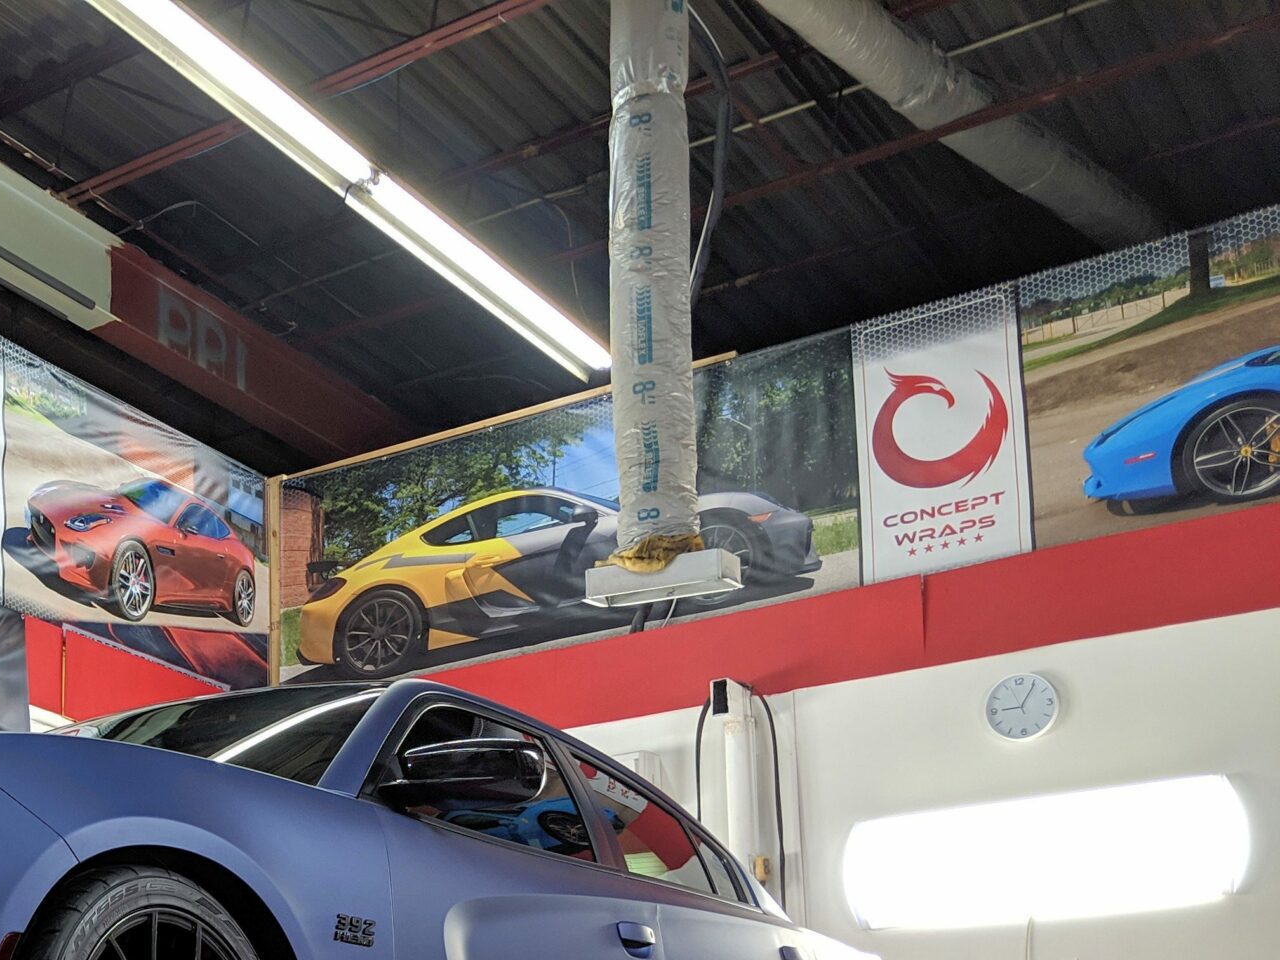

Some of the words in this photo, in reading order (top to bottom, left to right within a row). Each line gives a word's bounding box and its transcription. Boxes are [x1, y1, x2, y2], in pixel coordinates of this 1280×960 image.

[883, 491, 1006, 528] CONCEPT
[894, 514, 996, 546] WRAPS
[1014, 677, 1024, 686] 12
[1046, 698, 1053, 706] 3
[990, 708, 998, 716] 9
[1020, 728, 1027, 736] 6
[335, 913, 376, 936] 392
